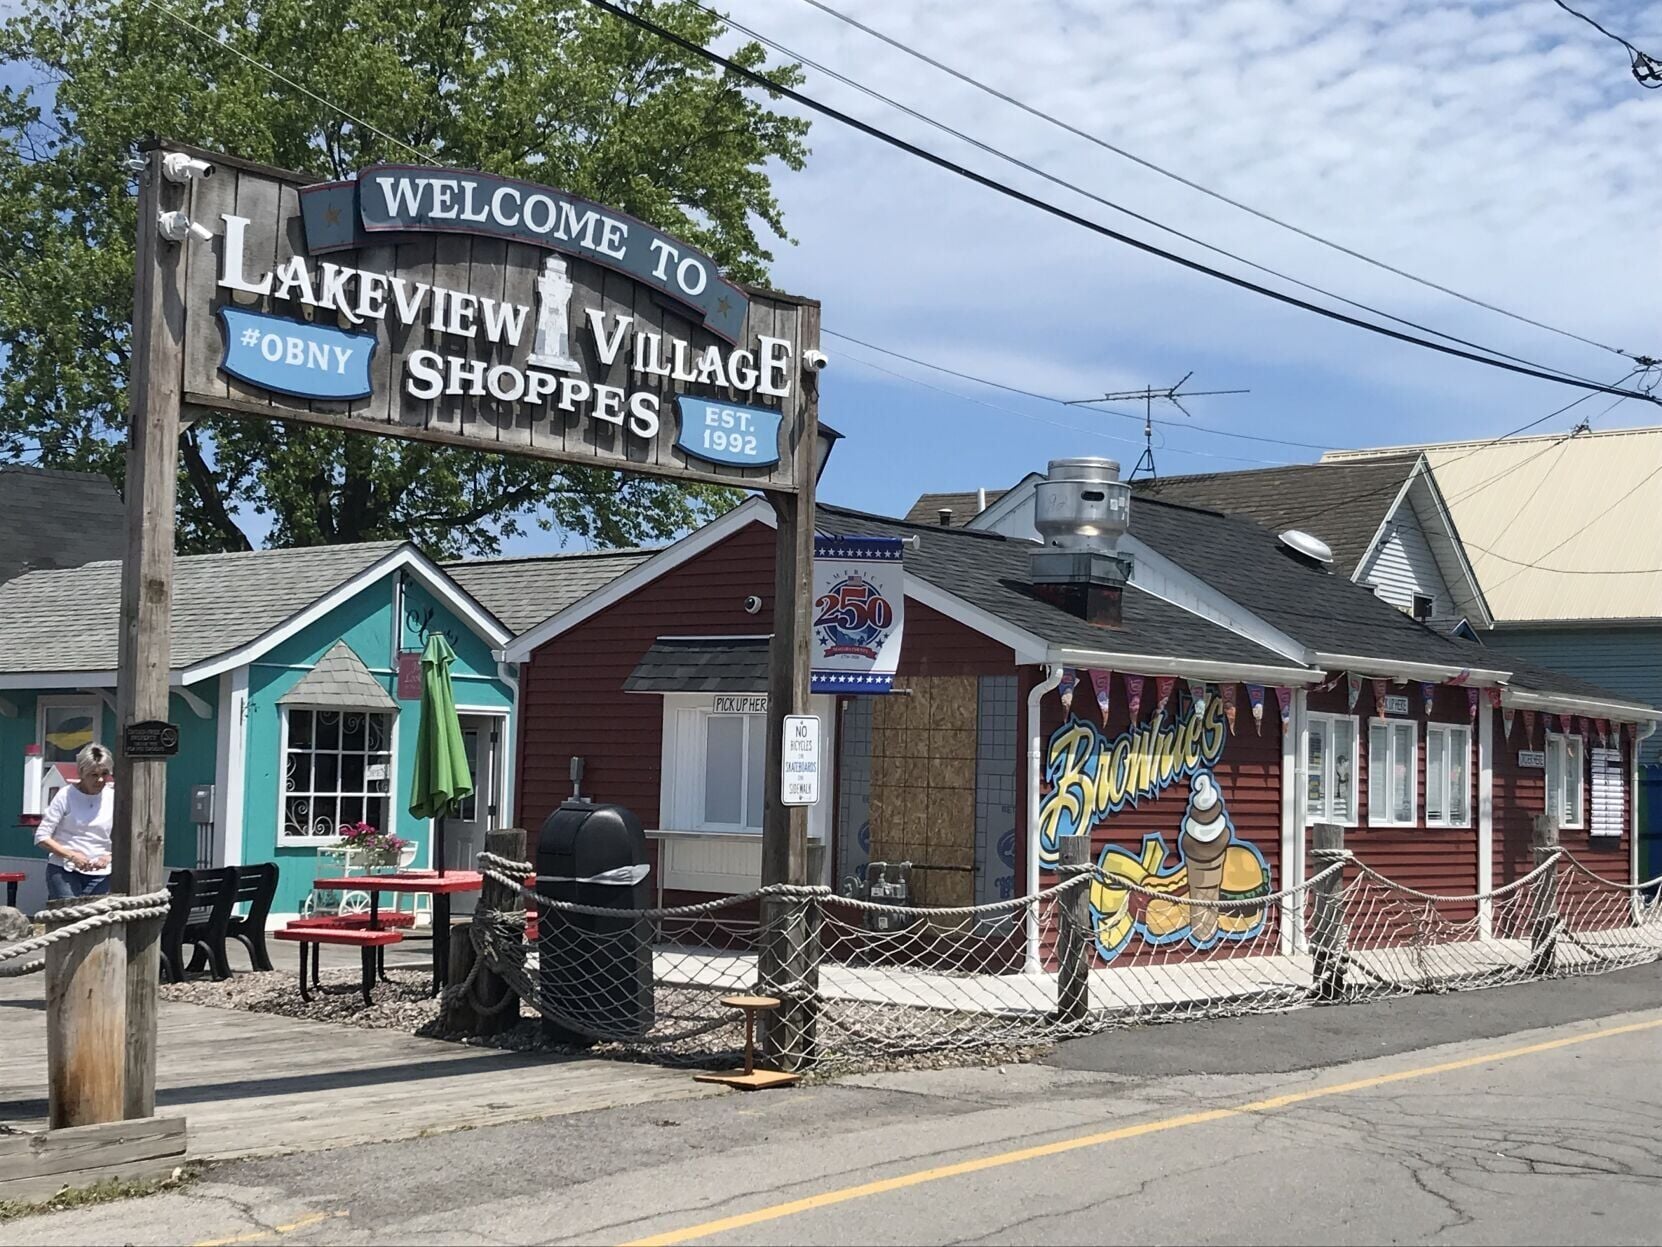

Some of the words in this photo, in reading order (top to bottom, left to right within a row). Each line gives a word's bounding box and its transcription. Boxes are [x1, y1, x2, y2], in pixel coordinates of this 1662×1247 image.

[375, 176, 629, 261] WELCOME
[650, 237, 707, 296] TO
[217, 213, 530, 347] LAKEVIEW
[584, 307, 793, 398] VILLAGE
[240, 328, 354, 375] #OBNY
[406, 349, 660, 439] SHOPPES
[705, 406, 755, 433] EST.
[703, 431, 757, 456] 1992
[814, 586, 893, 632] 250
[716, 697, 735, 711] PICK
[735, 697, 748, 711] UP
[748, 698, 767, 712] HER
[795, 725, 807, 737] NO
[789, 784, 812, 794] SIDEWALK
